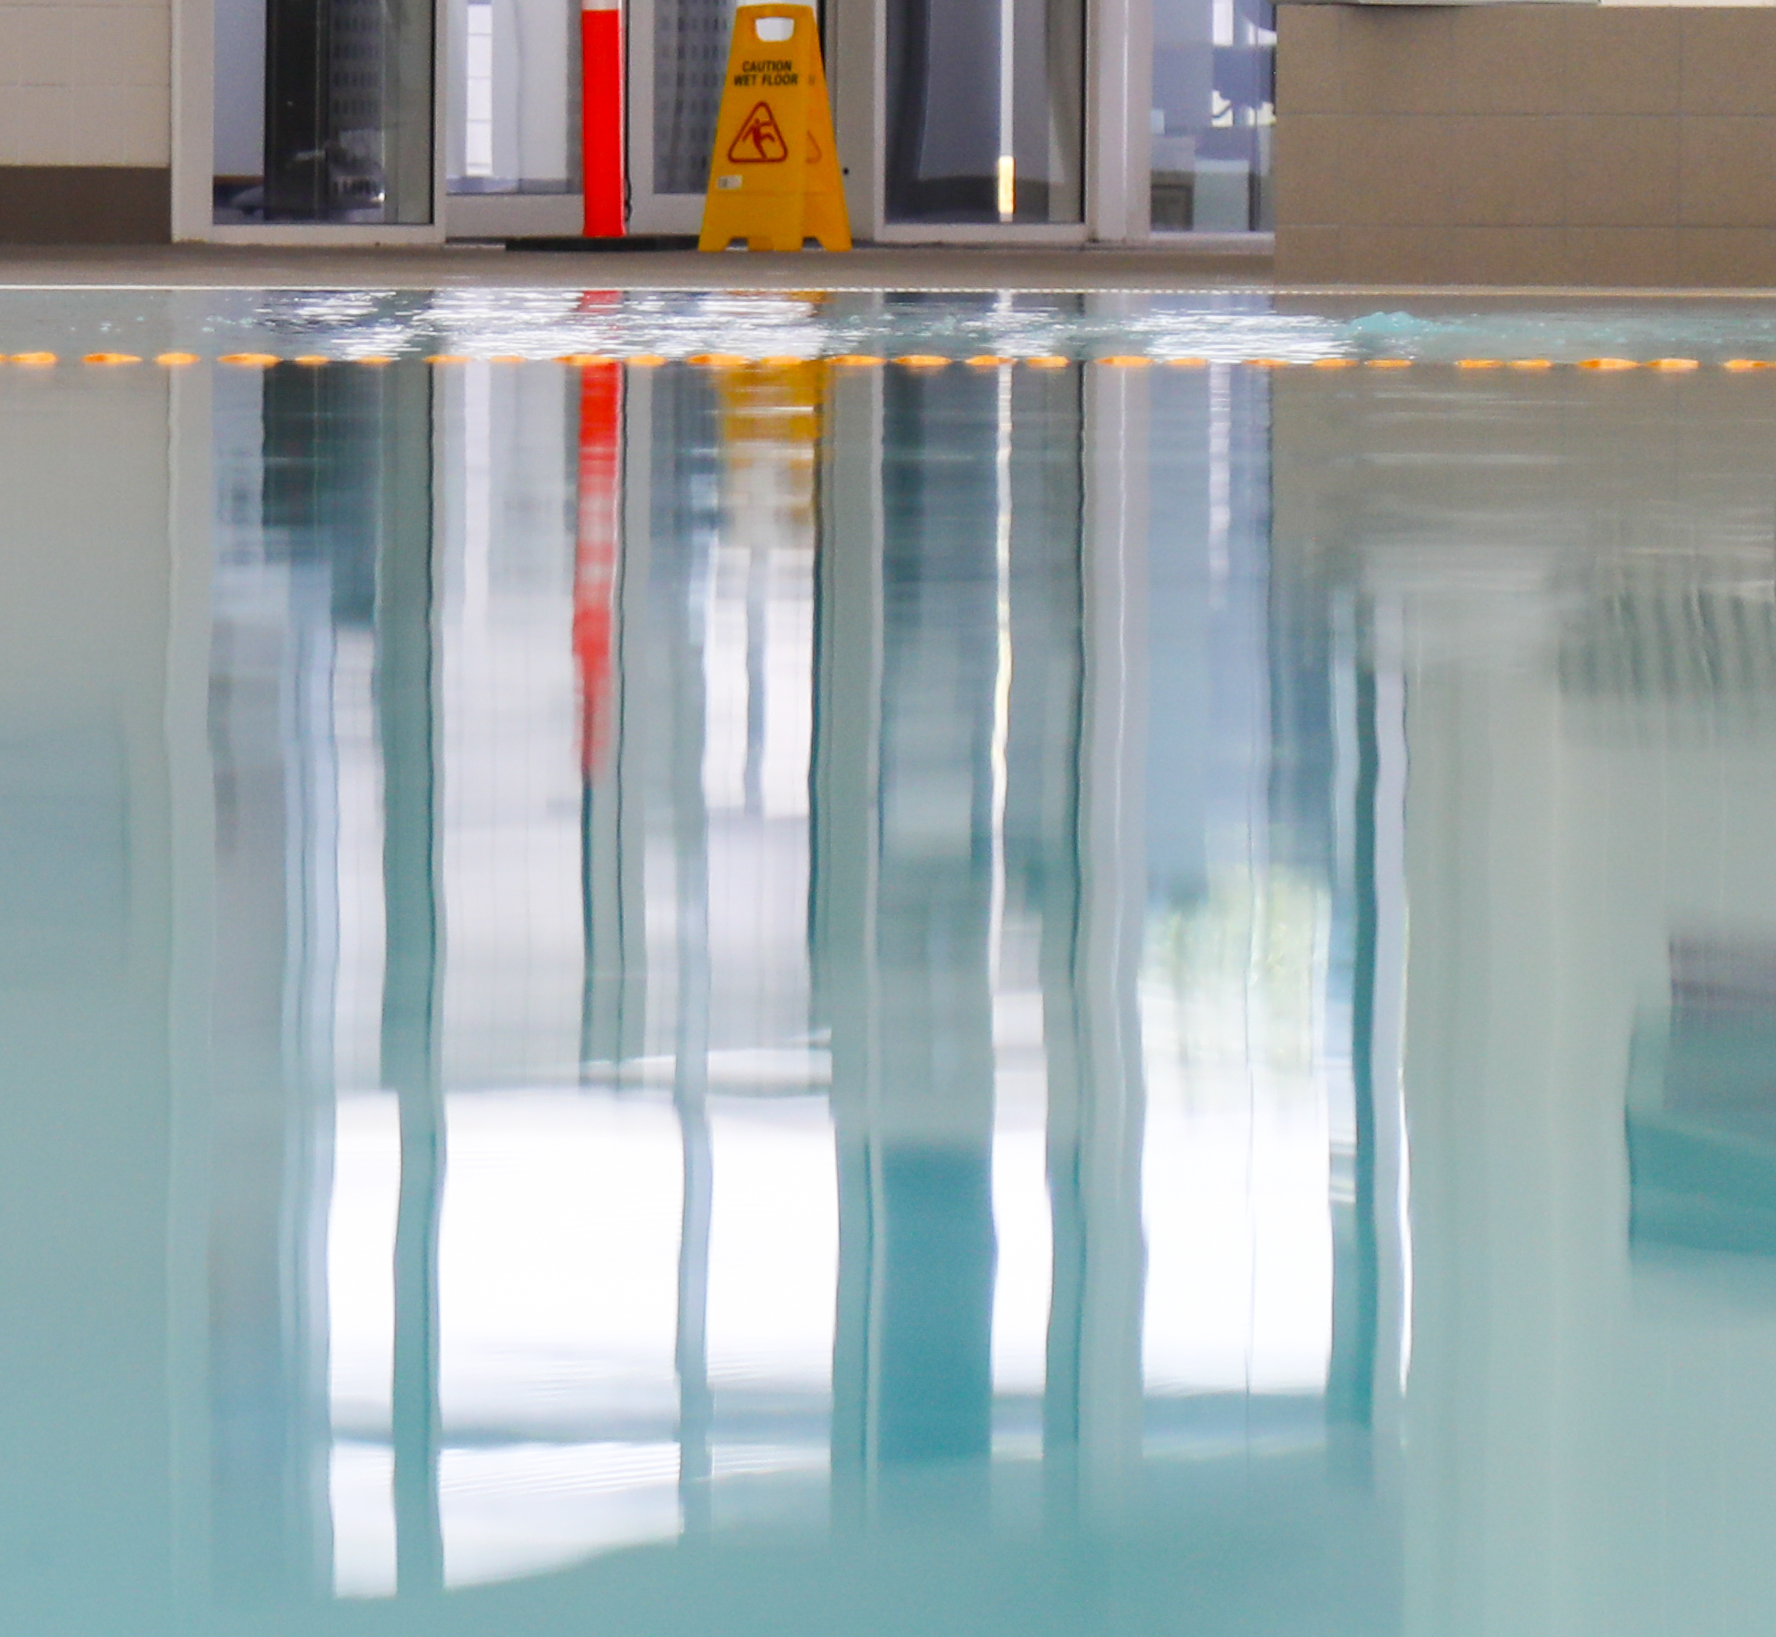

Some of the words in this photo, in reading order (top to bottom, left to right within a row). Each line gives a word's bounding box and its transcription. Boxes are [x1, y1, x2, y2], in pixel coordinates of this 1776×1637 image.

[742, 60, 792, 72] CAUTION
[734, 74, 756, 86] WET
[762, 73, 798, 85] FLOOR
